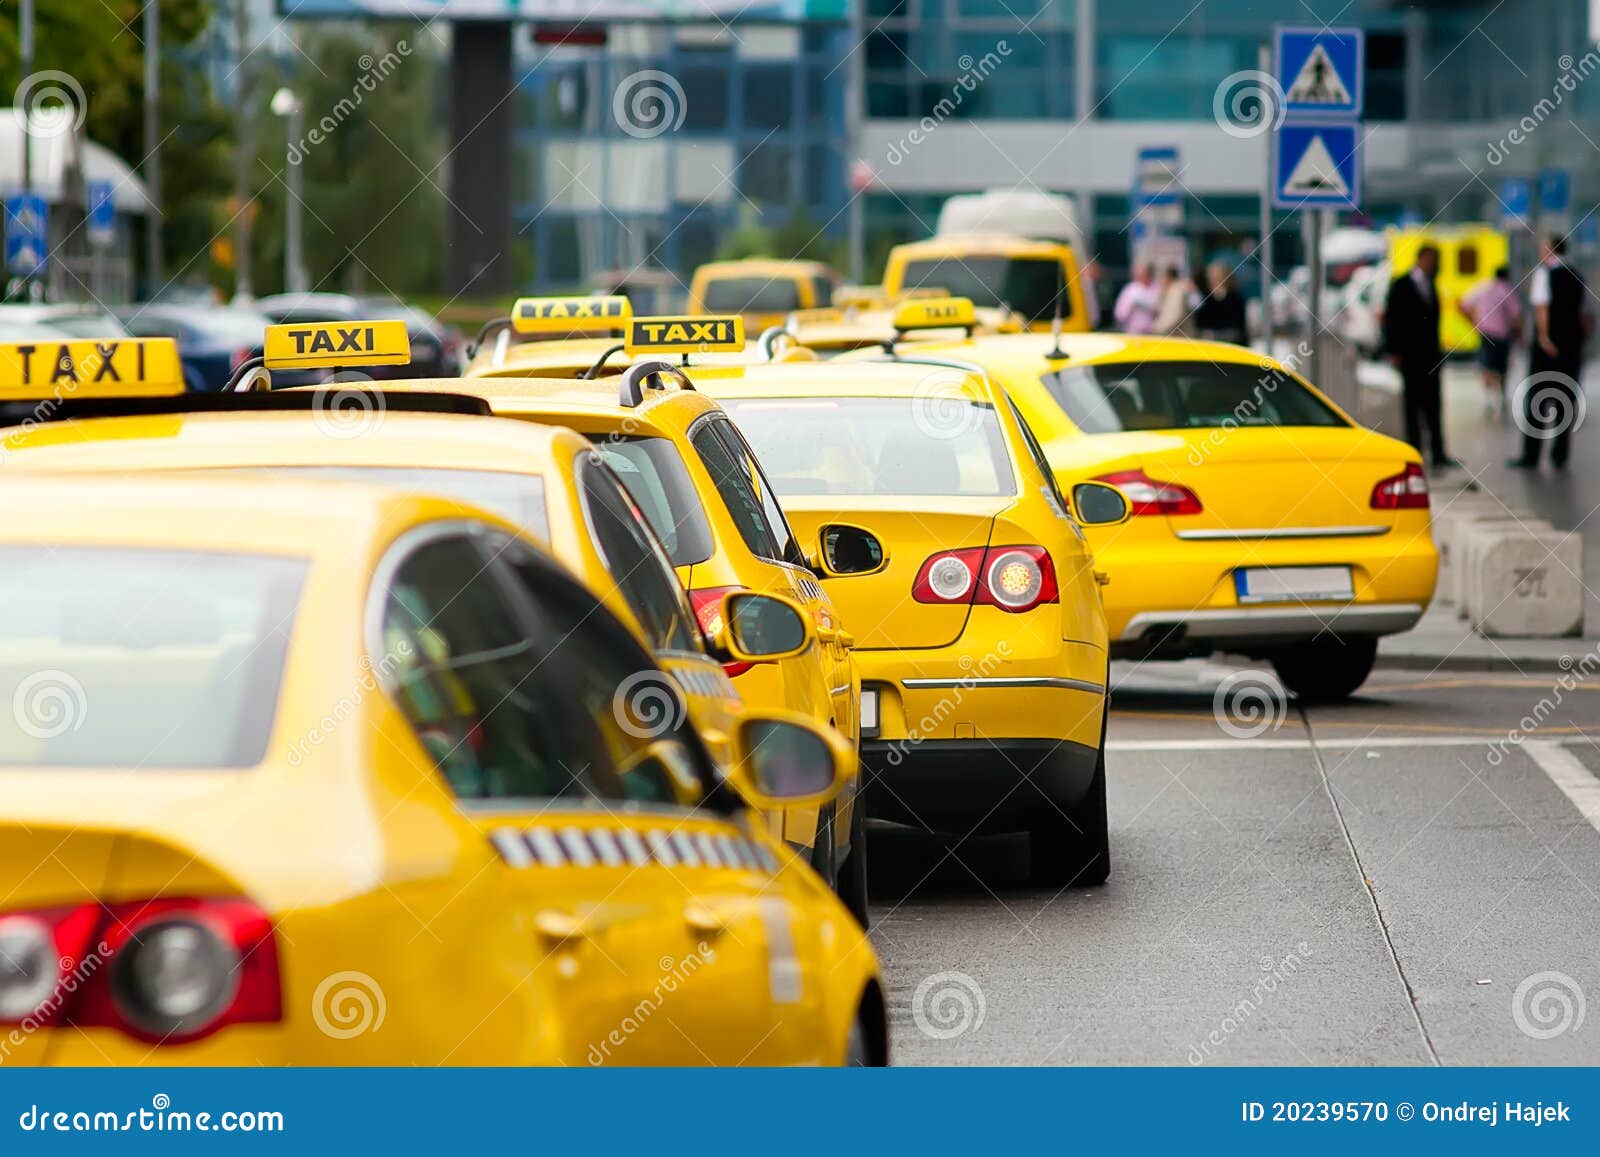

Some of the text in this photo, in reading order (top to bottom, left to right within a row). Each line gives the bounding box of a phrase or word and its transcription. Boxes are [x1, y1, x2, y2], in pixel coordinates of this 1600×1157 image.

[529, 302, 609, 318] TAXI
[288, 327, 375, 354] TAXI
[642, 322, 727, 342] TAXI
[17, 342, 146, 385] TAXI
